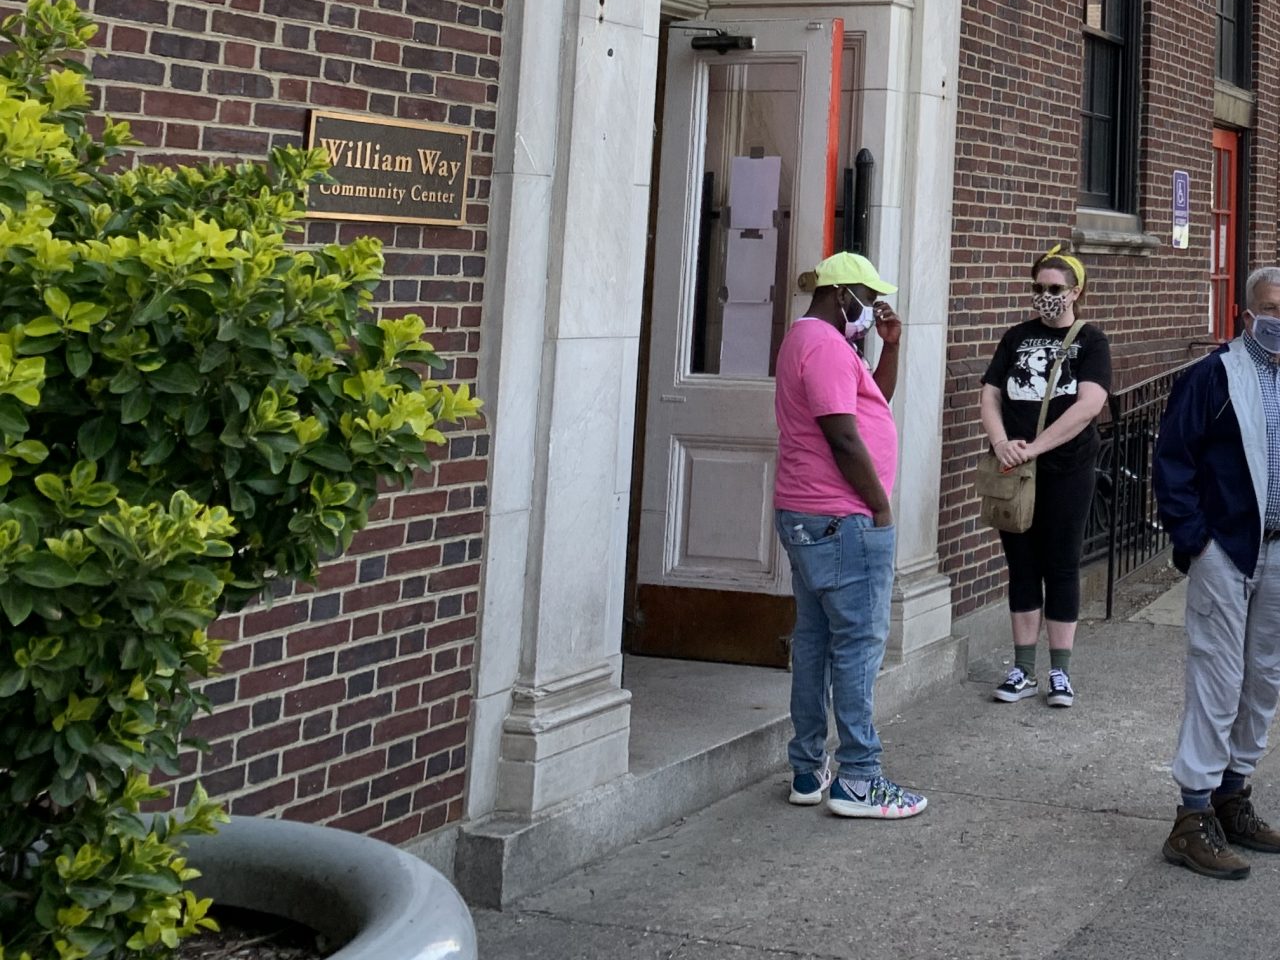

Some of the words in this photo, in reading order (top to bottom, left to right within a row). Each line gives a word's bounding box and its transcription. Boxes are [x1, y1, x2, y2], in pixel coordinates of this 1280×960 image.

[319, 137, 413, 173] William
[417, 148, 462, 185] Way
[319, 182, 405, 204] Community
[411, 185, 456, 204] Center
